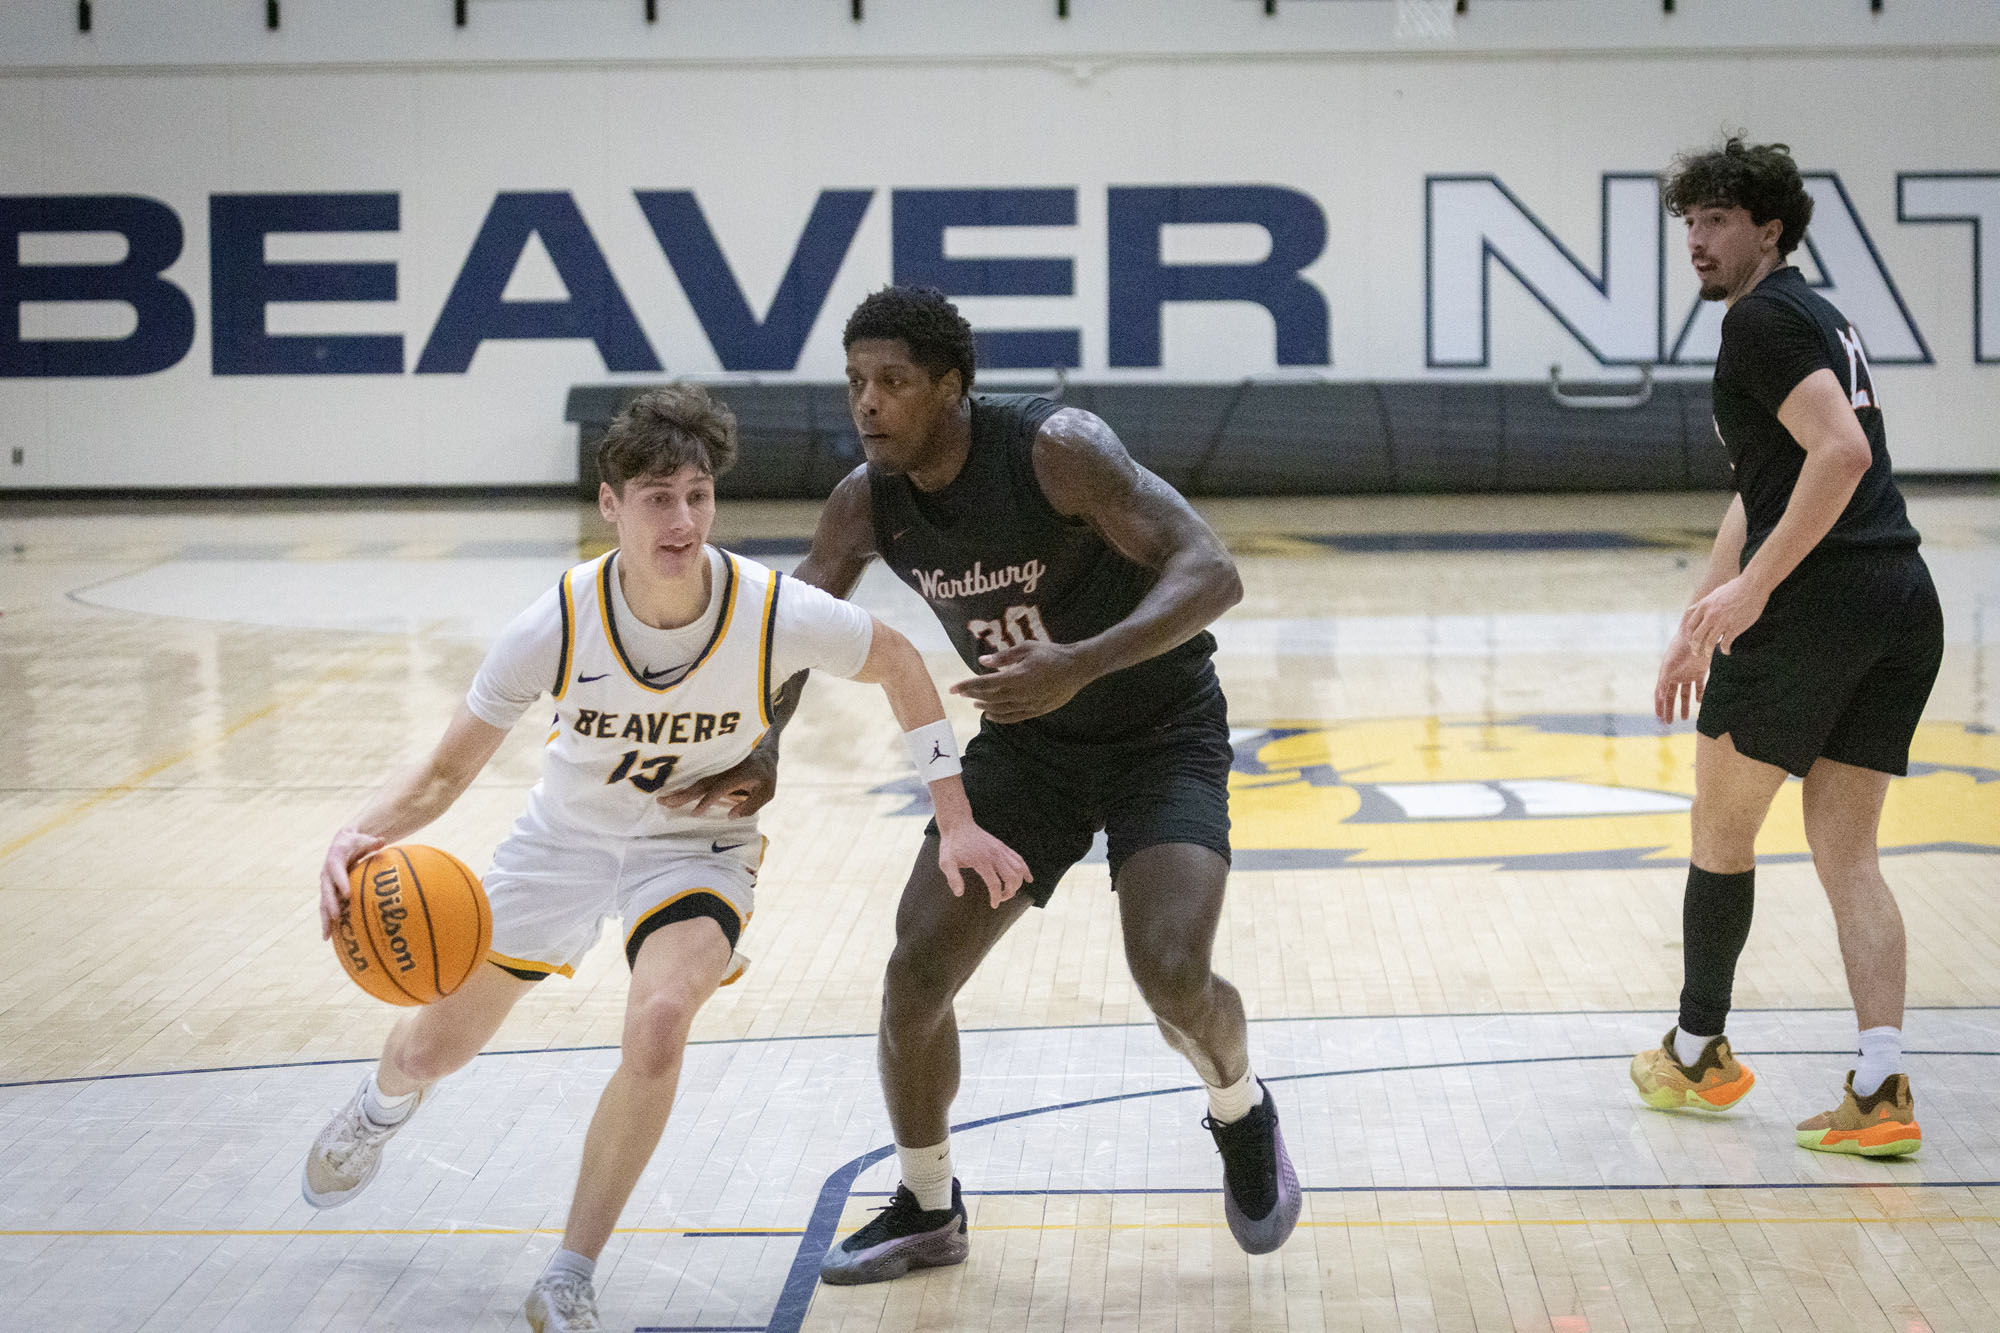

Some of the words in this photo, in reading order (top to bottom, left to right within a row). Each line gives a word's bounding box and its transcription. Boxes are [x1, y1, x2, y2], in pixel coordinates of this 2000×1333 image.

[0, 185, 1333, 378] BEAVER
[912, 559, 1046, 599] Wartburg
[573, 708, 742, 744] BEAVERS
[605, 750, 680, 794] 13
[373, 865, 416, 973] Wilson
